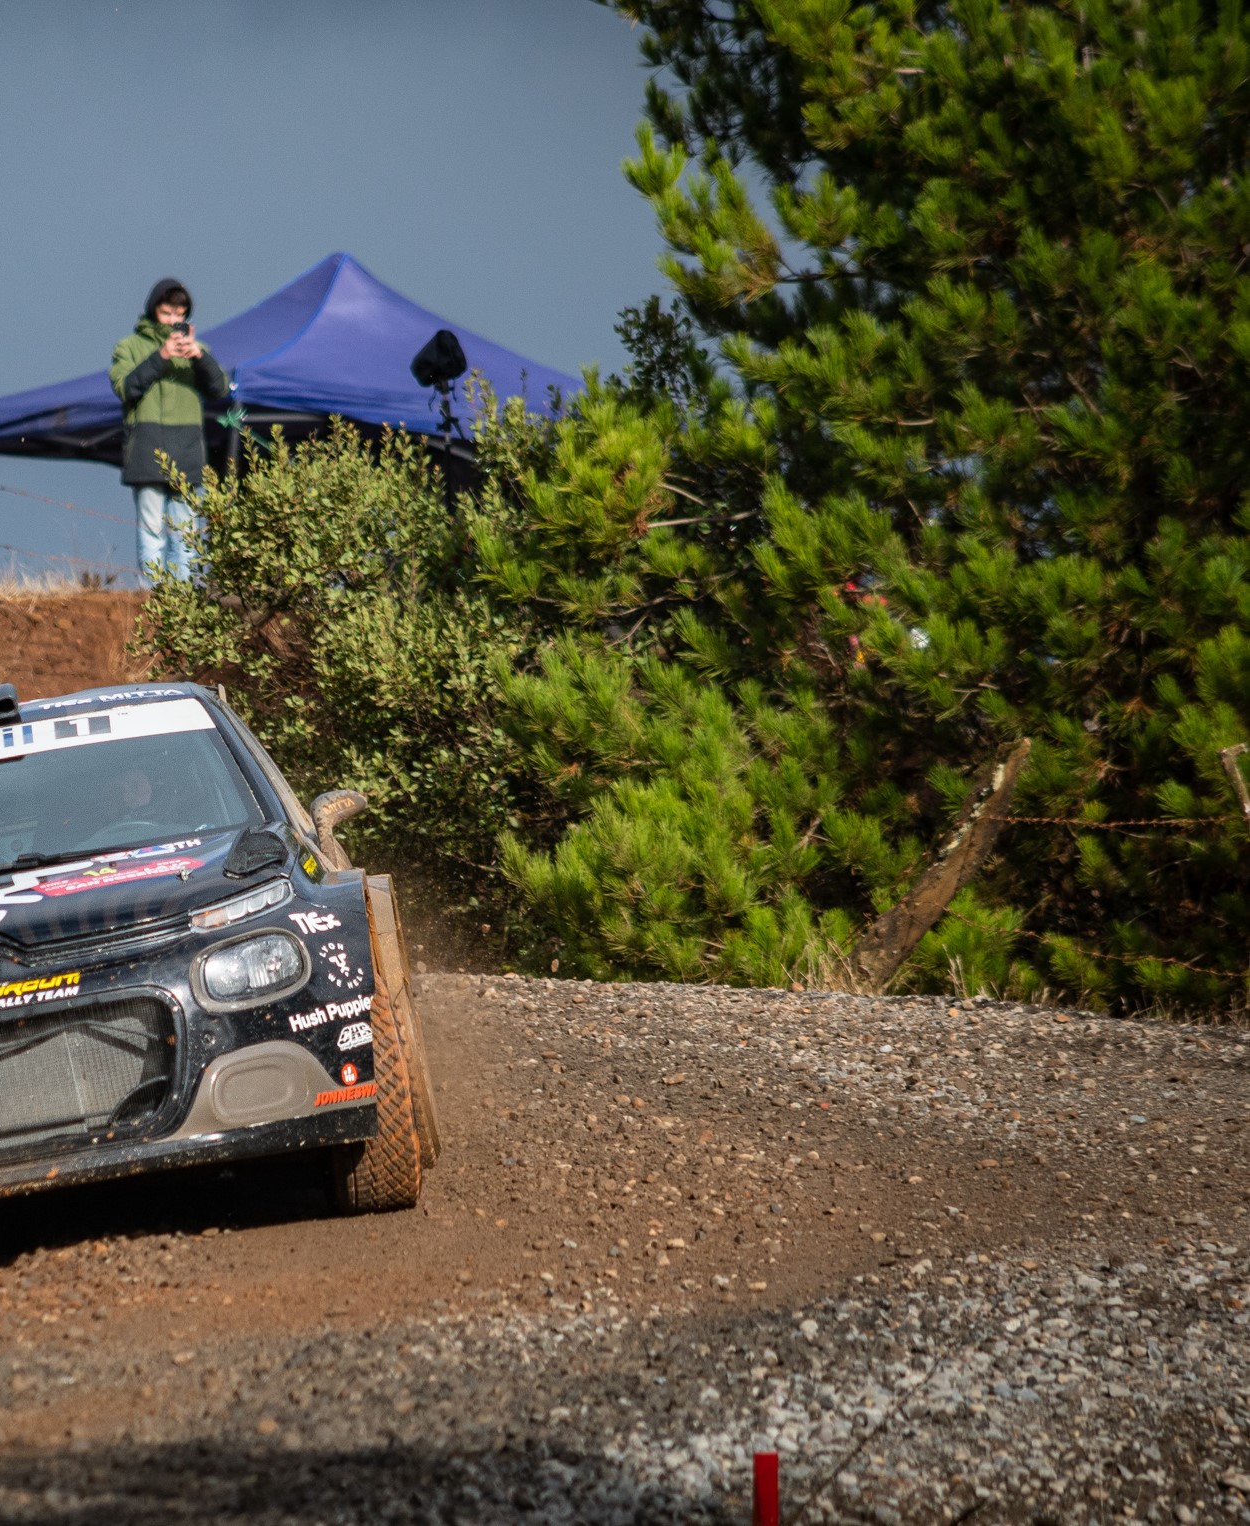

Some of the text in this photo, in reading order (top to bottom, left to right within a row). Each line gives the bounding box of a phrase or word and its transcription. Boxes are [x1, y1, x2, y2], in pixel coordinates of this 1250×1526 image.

[98, 689, 185, 703] MITTA
[35, 985, 80, 1002] TEAM
[289, 994, 374, 1033] Hush Puppie
